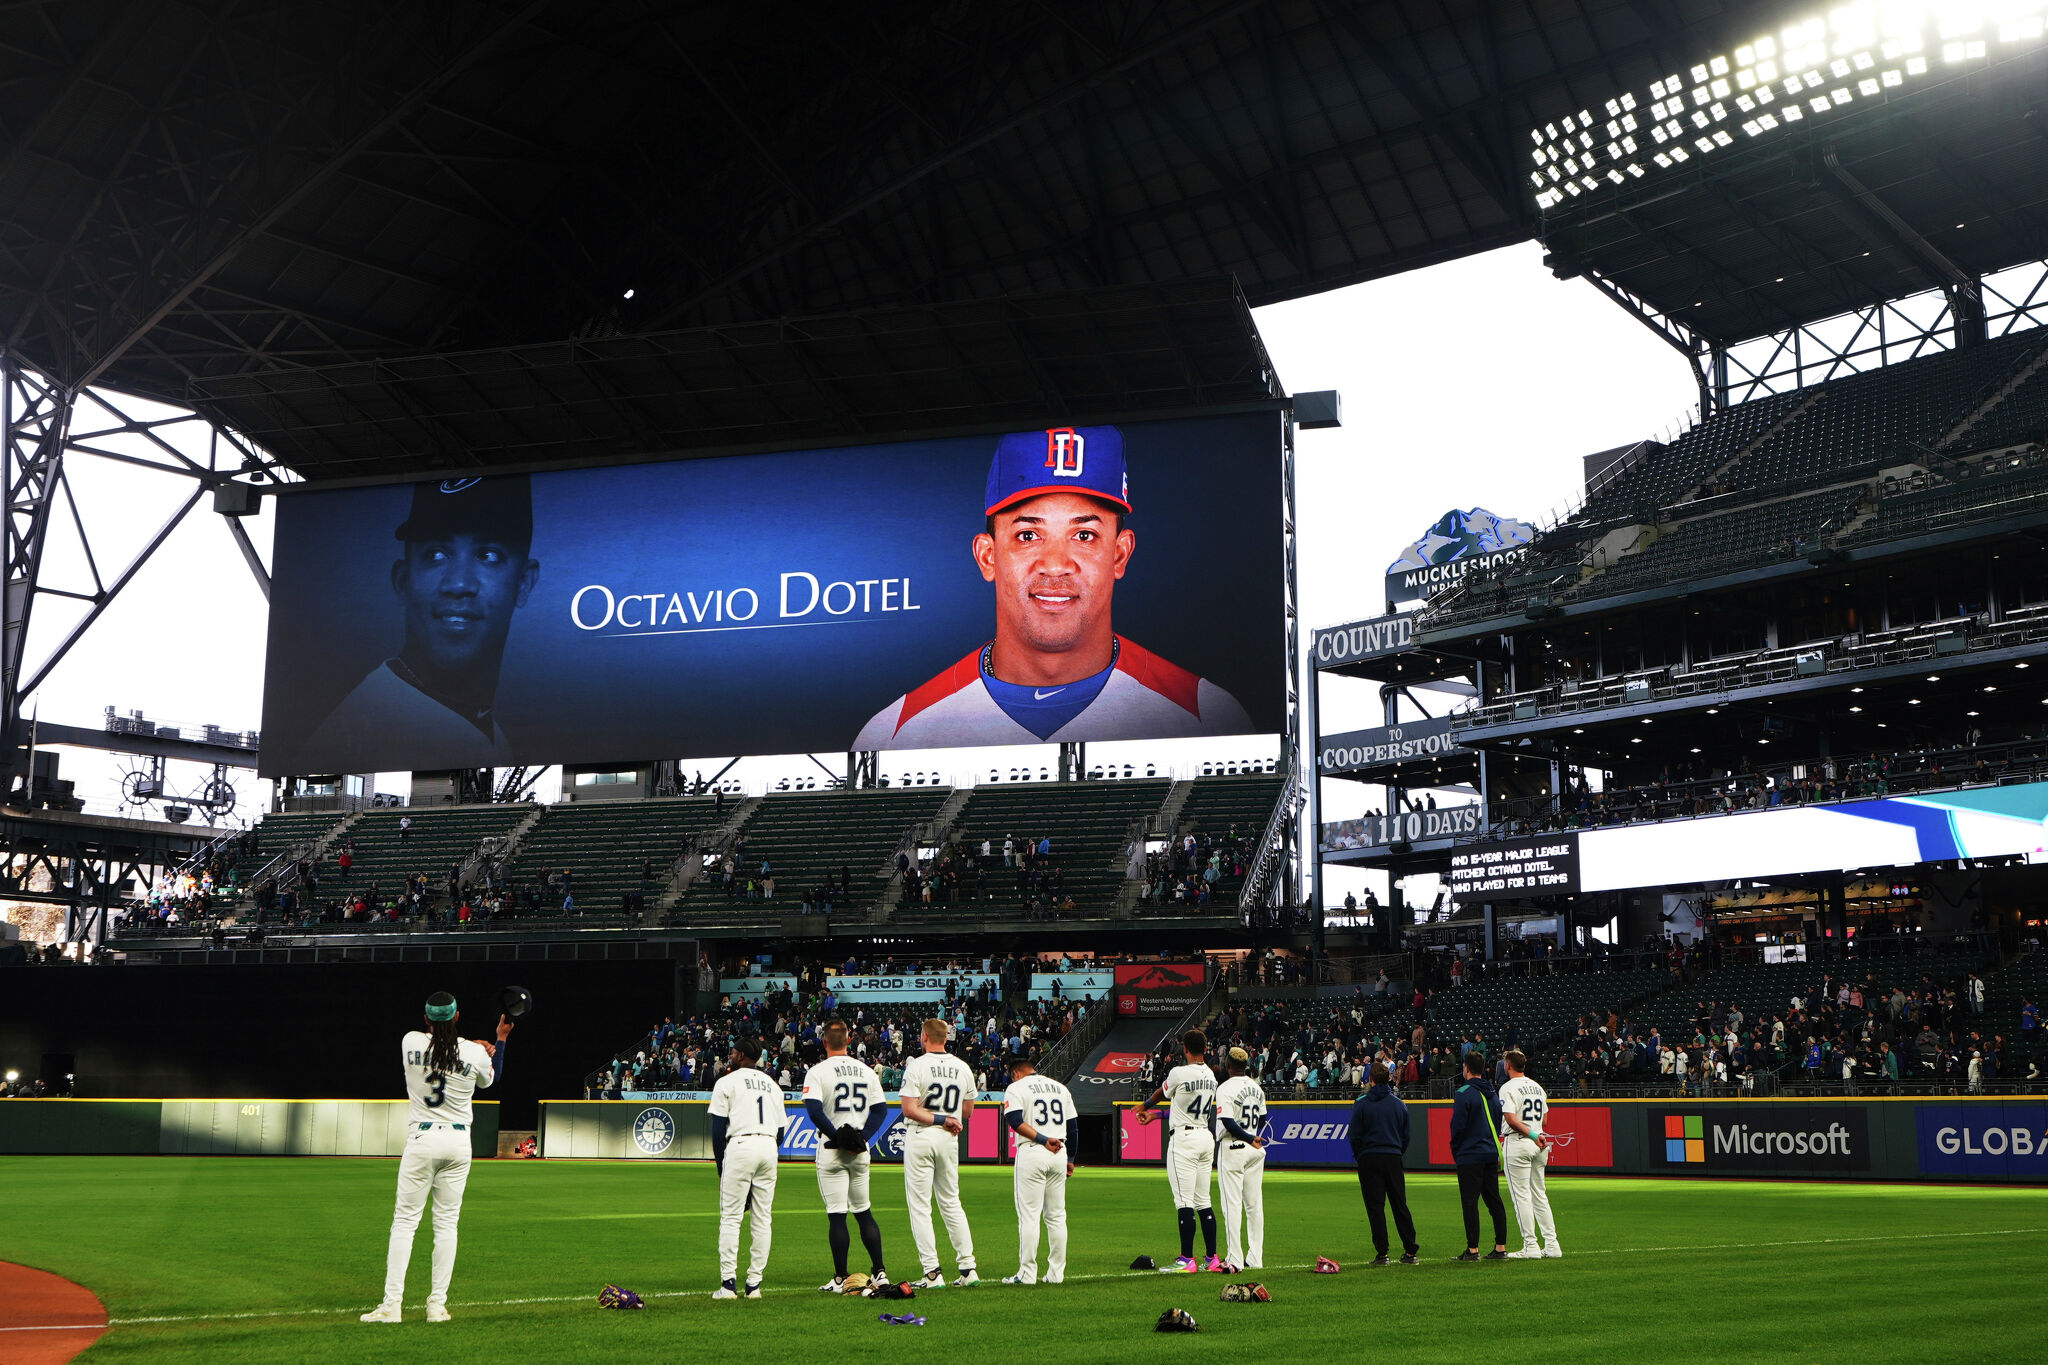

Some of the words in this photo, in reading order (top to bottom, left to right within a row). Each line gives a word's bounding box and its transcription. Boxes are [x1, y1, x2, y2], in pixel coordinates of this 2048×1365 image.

[1388, 728, 1403, 741] TO
[1323, 732, 1456, 769] COOPERSTOW
[1378, 812, 1422, 844] 110
[1426, 808, 1476, 836] DAYS
[1451, 856, 1469, 867] AND
[1505, 848, 1534, 861] MAJOR
[1535, 844, 1570, 857] LEAGUE
[1452, 867, 1486, 880] PITCHER
[1488, 863, 1522, 877] OCTAVIO
[1452, 882, 1471, 894] WHO
[1473, 879, 1505, 892] PLAYED
[1507, 877, 1525, 889] FOR
[1527, 876, 1536, 887] 13
[1538, 872, 1568, 886] TEAMS
[852, 978, 904, 989] J-ROD
[1140, 1005, 1160, 1013] Toyota
[1165, 997, 1199, 1006] Washington
[834, 1066, 865, 1078] MOORE
[930, 1066, 960, 1079] RALEY
[424, 1070, 446, 1108] 3
[744, 1078, 772, 1093] BLISS
[1028, 1084, 1062, 1095] SOLANO
[1518, 1085, 1542, 1096] RALEIGH
[834, 1083, 868, 1112] 25
[924, 1083, 960, 1113] 20
[1187, 1094, 1213, 1121] 44
[241, 1104, 260, 1116] 401
[637, 1110, 671, 1126] SEATTLE
[757, 1095, 763, 1124] 1
[1034, 1099, 1064, 1126] 39
[1240, 1104, 1260, 1129] 56
[1522, 1098, 1543, 1121] 29
[637, 1134, 671, 1152] MARINERS
[1713, 1122, 1851, 1155] Microsoft
